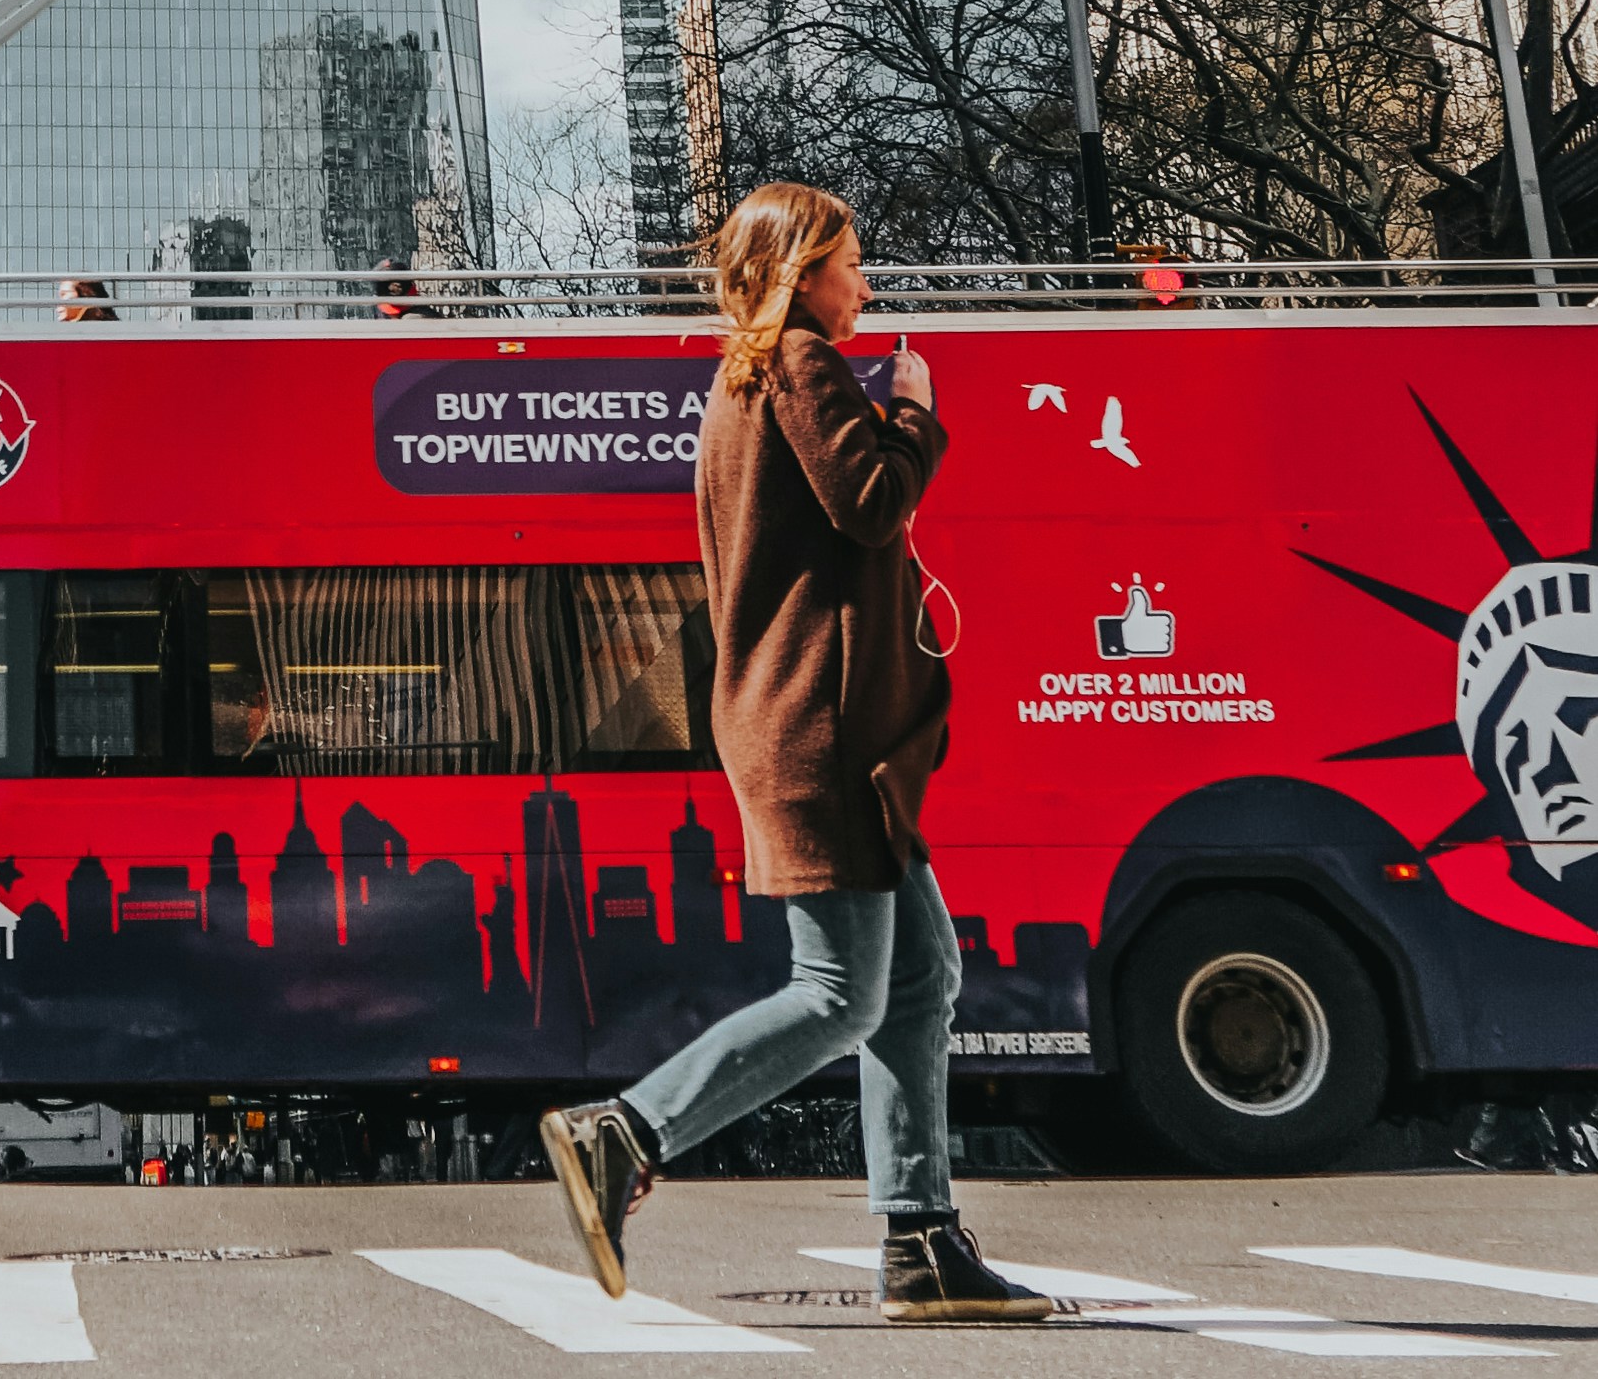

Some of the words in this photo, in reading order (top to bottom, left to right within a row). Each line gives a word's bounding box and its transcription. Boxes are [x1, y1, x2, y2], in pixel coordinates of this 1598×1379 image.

[436, 393, 508, 421] BUY
[518, 391, 669, 420] TICKETS
[393, 432, 701, 463] TOPVIEWNYC.CO
[1039, 673, 1114, 695] OVER
[1117, 673, 1135, 695] 2
[1139, 673, 1246, 695] MILLION
[1018, 700, 1105, 723] HAPPY
[1111, 699, 1275, 723] CUSTOMERS
